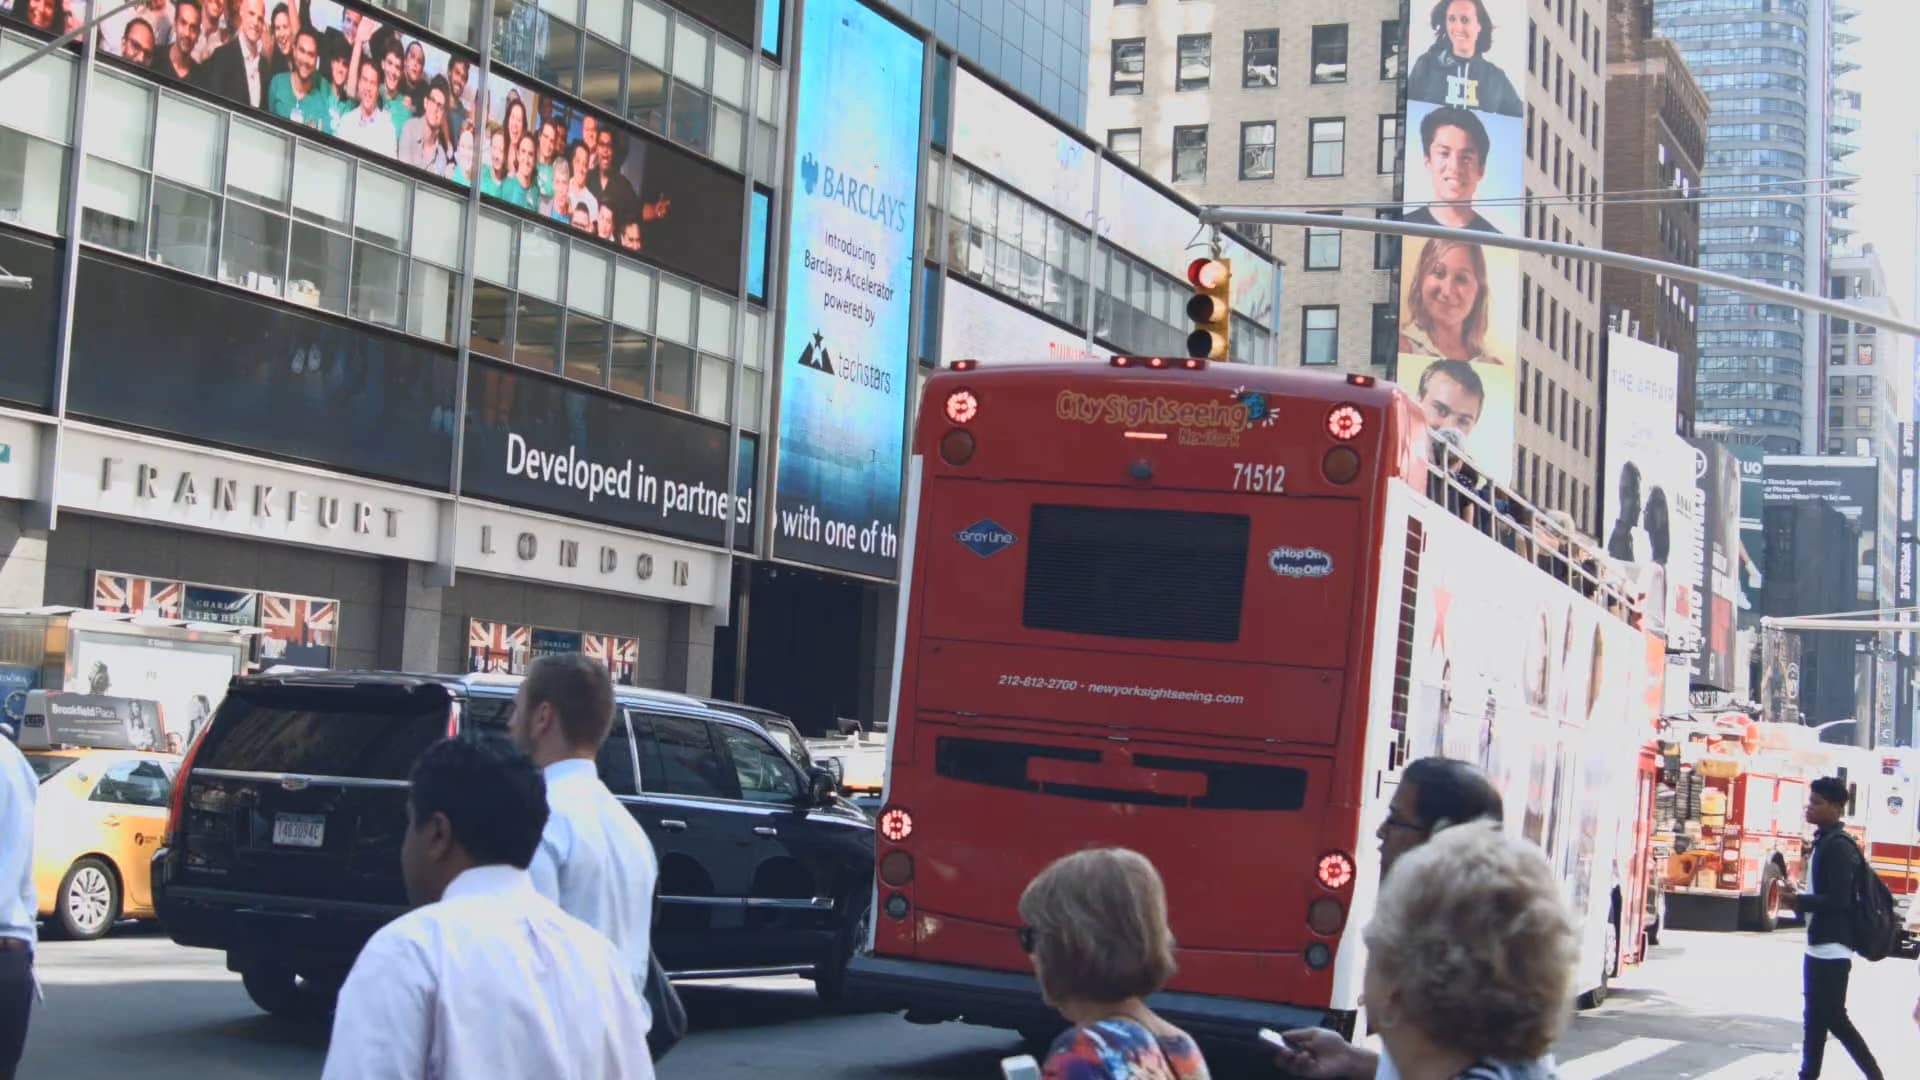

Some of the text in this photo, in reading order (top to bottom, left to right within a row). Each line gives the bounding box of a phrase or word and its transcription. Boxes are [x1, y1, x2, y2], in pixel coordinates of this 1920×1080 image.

[823, 166, 907, 233] BARCLAYS
[804, 249, 895, 302] Barclays Accelerator
[823, 291, 876, 328] powered by
[838, 354, 892, 395] techstars
[505, 432, 632, 503] Developed
[637, 464, 657, 504] in
[1232, 463, 1286, 493] 71512
[102, 456, 404, 538] FRANKFURT
[782, 504, 898, 559] with one of th
[481, 525, 690, 587] LONDON
[1280, 547, 1322, 561] Hop On
[1280, 563, 1303, 577] Hop
[52, 703, 95, 718] Brookfield
[998, 675, 1245, 705] 212-812-2700 newyorksightseeing.com
